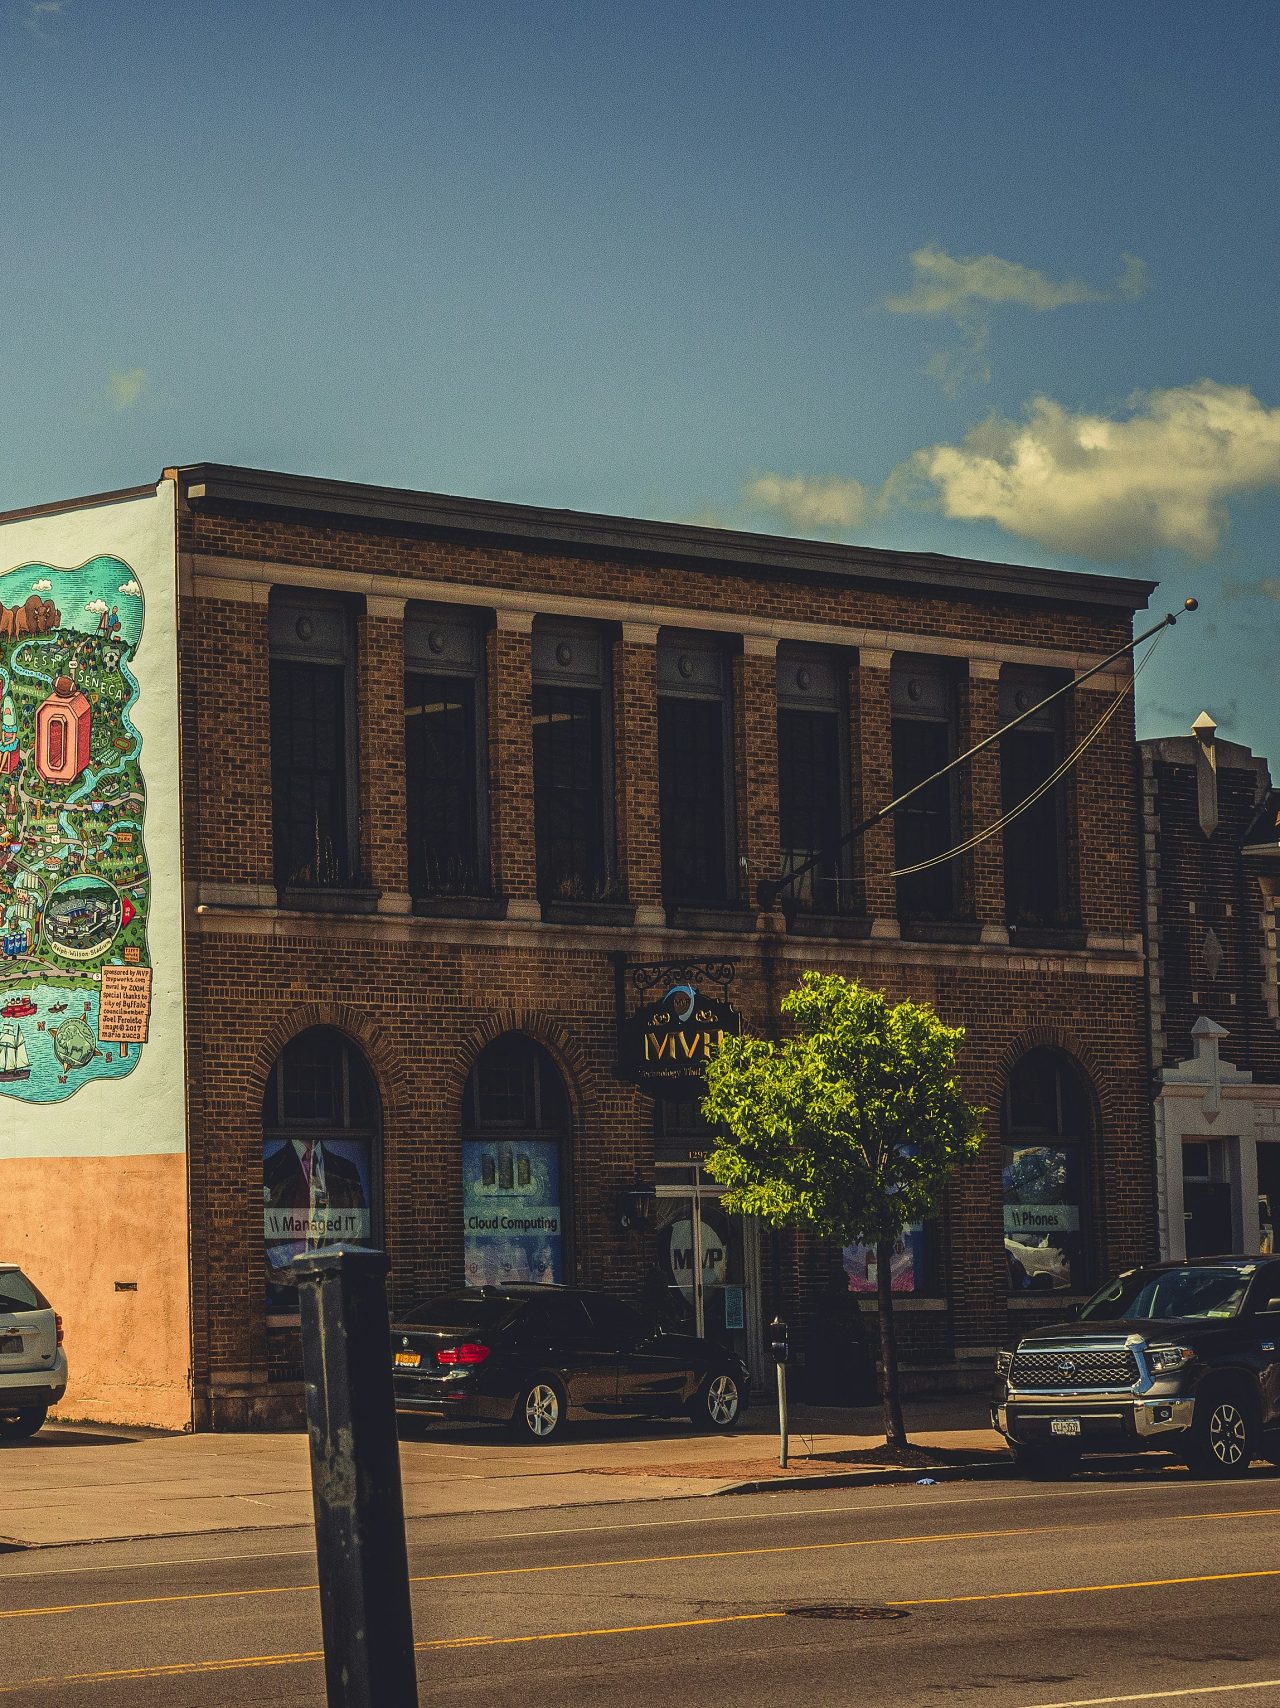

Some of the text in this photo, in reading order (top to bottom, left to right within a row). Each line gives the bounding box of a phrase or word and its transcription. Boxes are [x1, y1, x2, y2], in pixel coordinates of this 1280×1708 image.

[24, 653, 58, 669] WEST
[77, 671, 122, 700] SENECA
[12, 685, 47, 699] GARDENVILLE
[103, 969, 128, 977] sponsored
[105, 976, 146, 984] mvpworks.com
[102, 991, 122, 999] special
[122, 991, 141, 1000] thanks
[102, 1015, 116, 1023] Joel
[125, 1024, 142, 1032] 2017
[101, 1031, 141, 1040] mario zucca
[105, 1051, 113, 1063] S
[57, 1075, 69, 1084] W
[688, 1151, 708, 1159] 1297
[1022, 1211, 1059, 1226] Phones
[282, 1216, 342, 1235] Managed
[345, 1216, 357, 1232] IT
[468, 1216, 558, 1232] Cloud Computing
